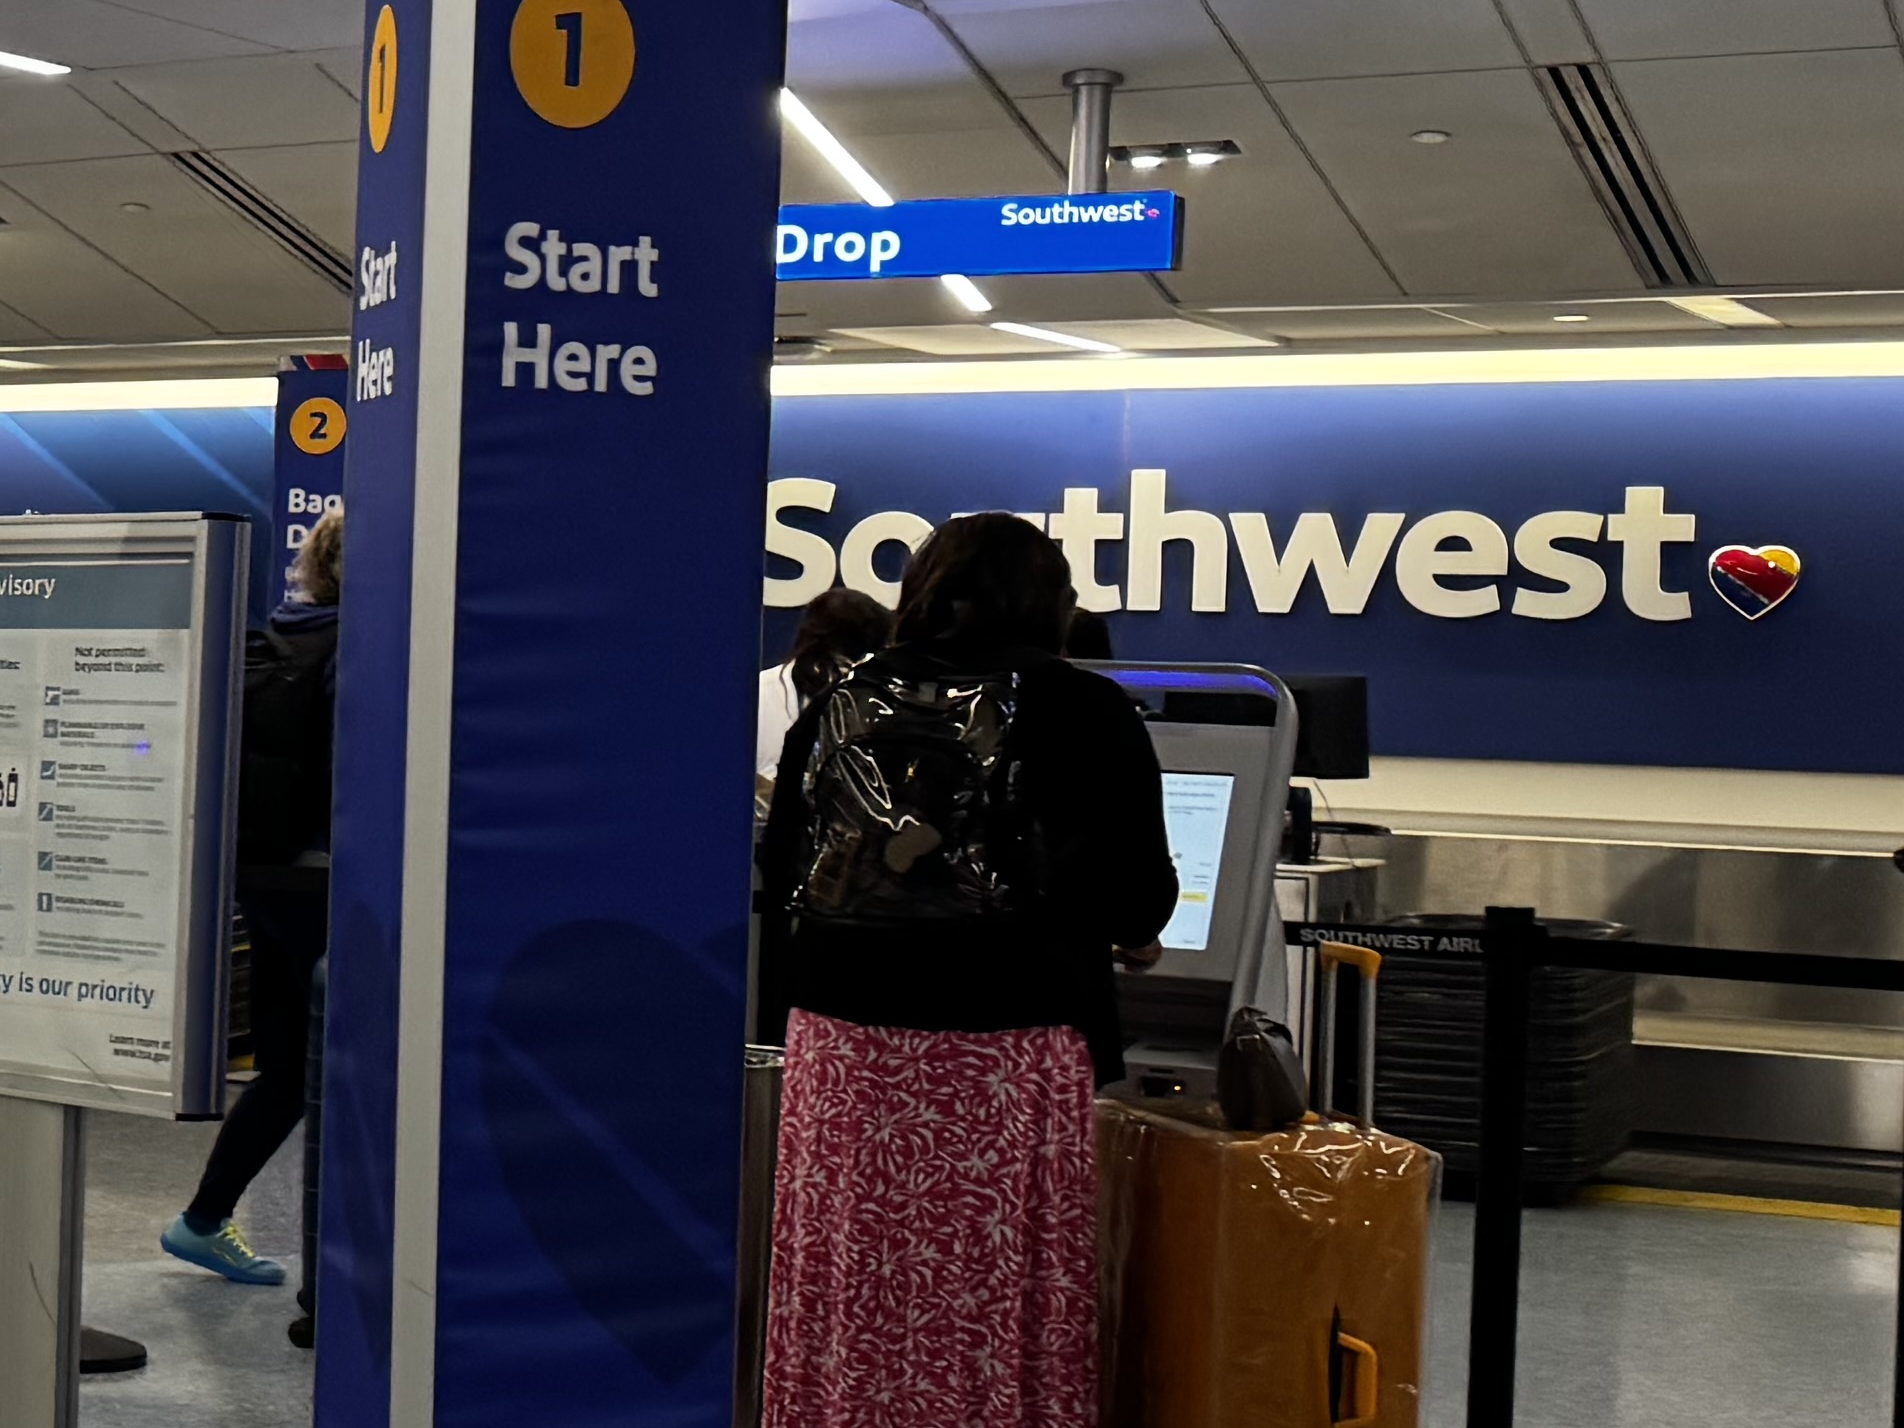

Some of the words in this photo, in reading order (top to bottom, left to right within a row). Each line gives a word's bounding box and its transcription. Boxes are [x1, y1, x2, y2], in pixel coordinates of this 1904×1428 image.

[376, 43, 388, 114] 1
[555, 12, 582, 88] 1
[503, 221, 660, 298] Start
[775, 223, 900, 273] Drop
[999, 199, 1144, 227] Southwest
[358, 240, 397, 311] Start
[355, 338, 394, 402] Here
[500, 321, 658, 397] Here
[309, 411, 328, 440] 2
[760, 468, 1697, 622] Sothwest
[1298, 927, 1435, 952] SOUTHWEST
[1435, 934, 1485, 955] AIRL
[18, 971, 34, 993] is
[38, 977, 73, 998] our
[77, 979, 155, 1010] priority
